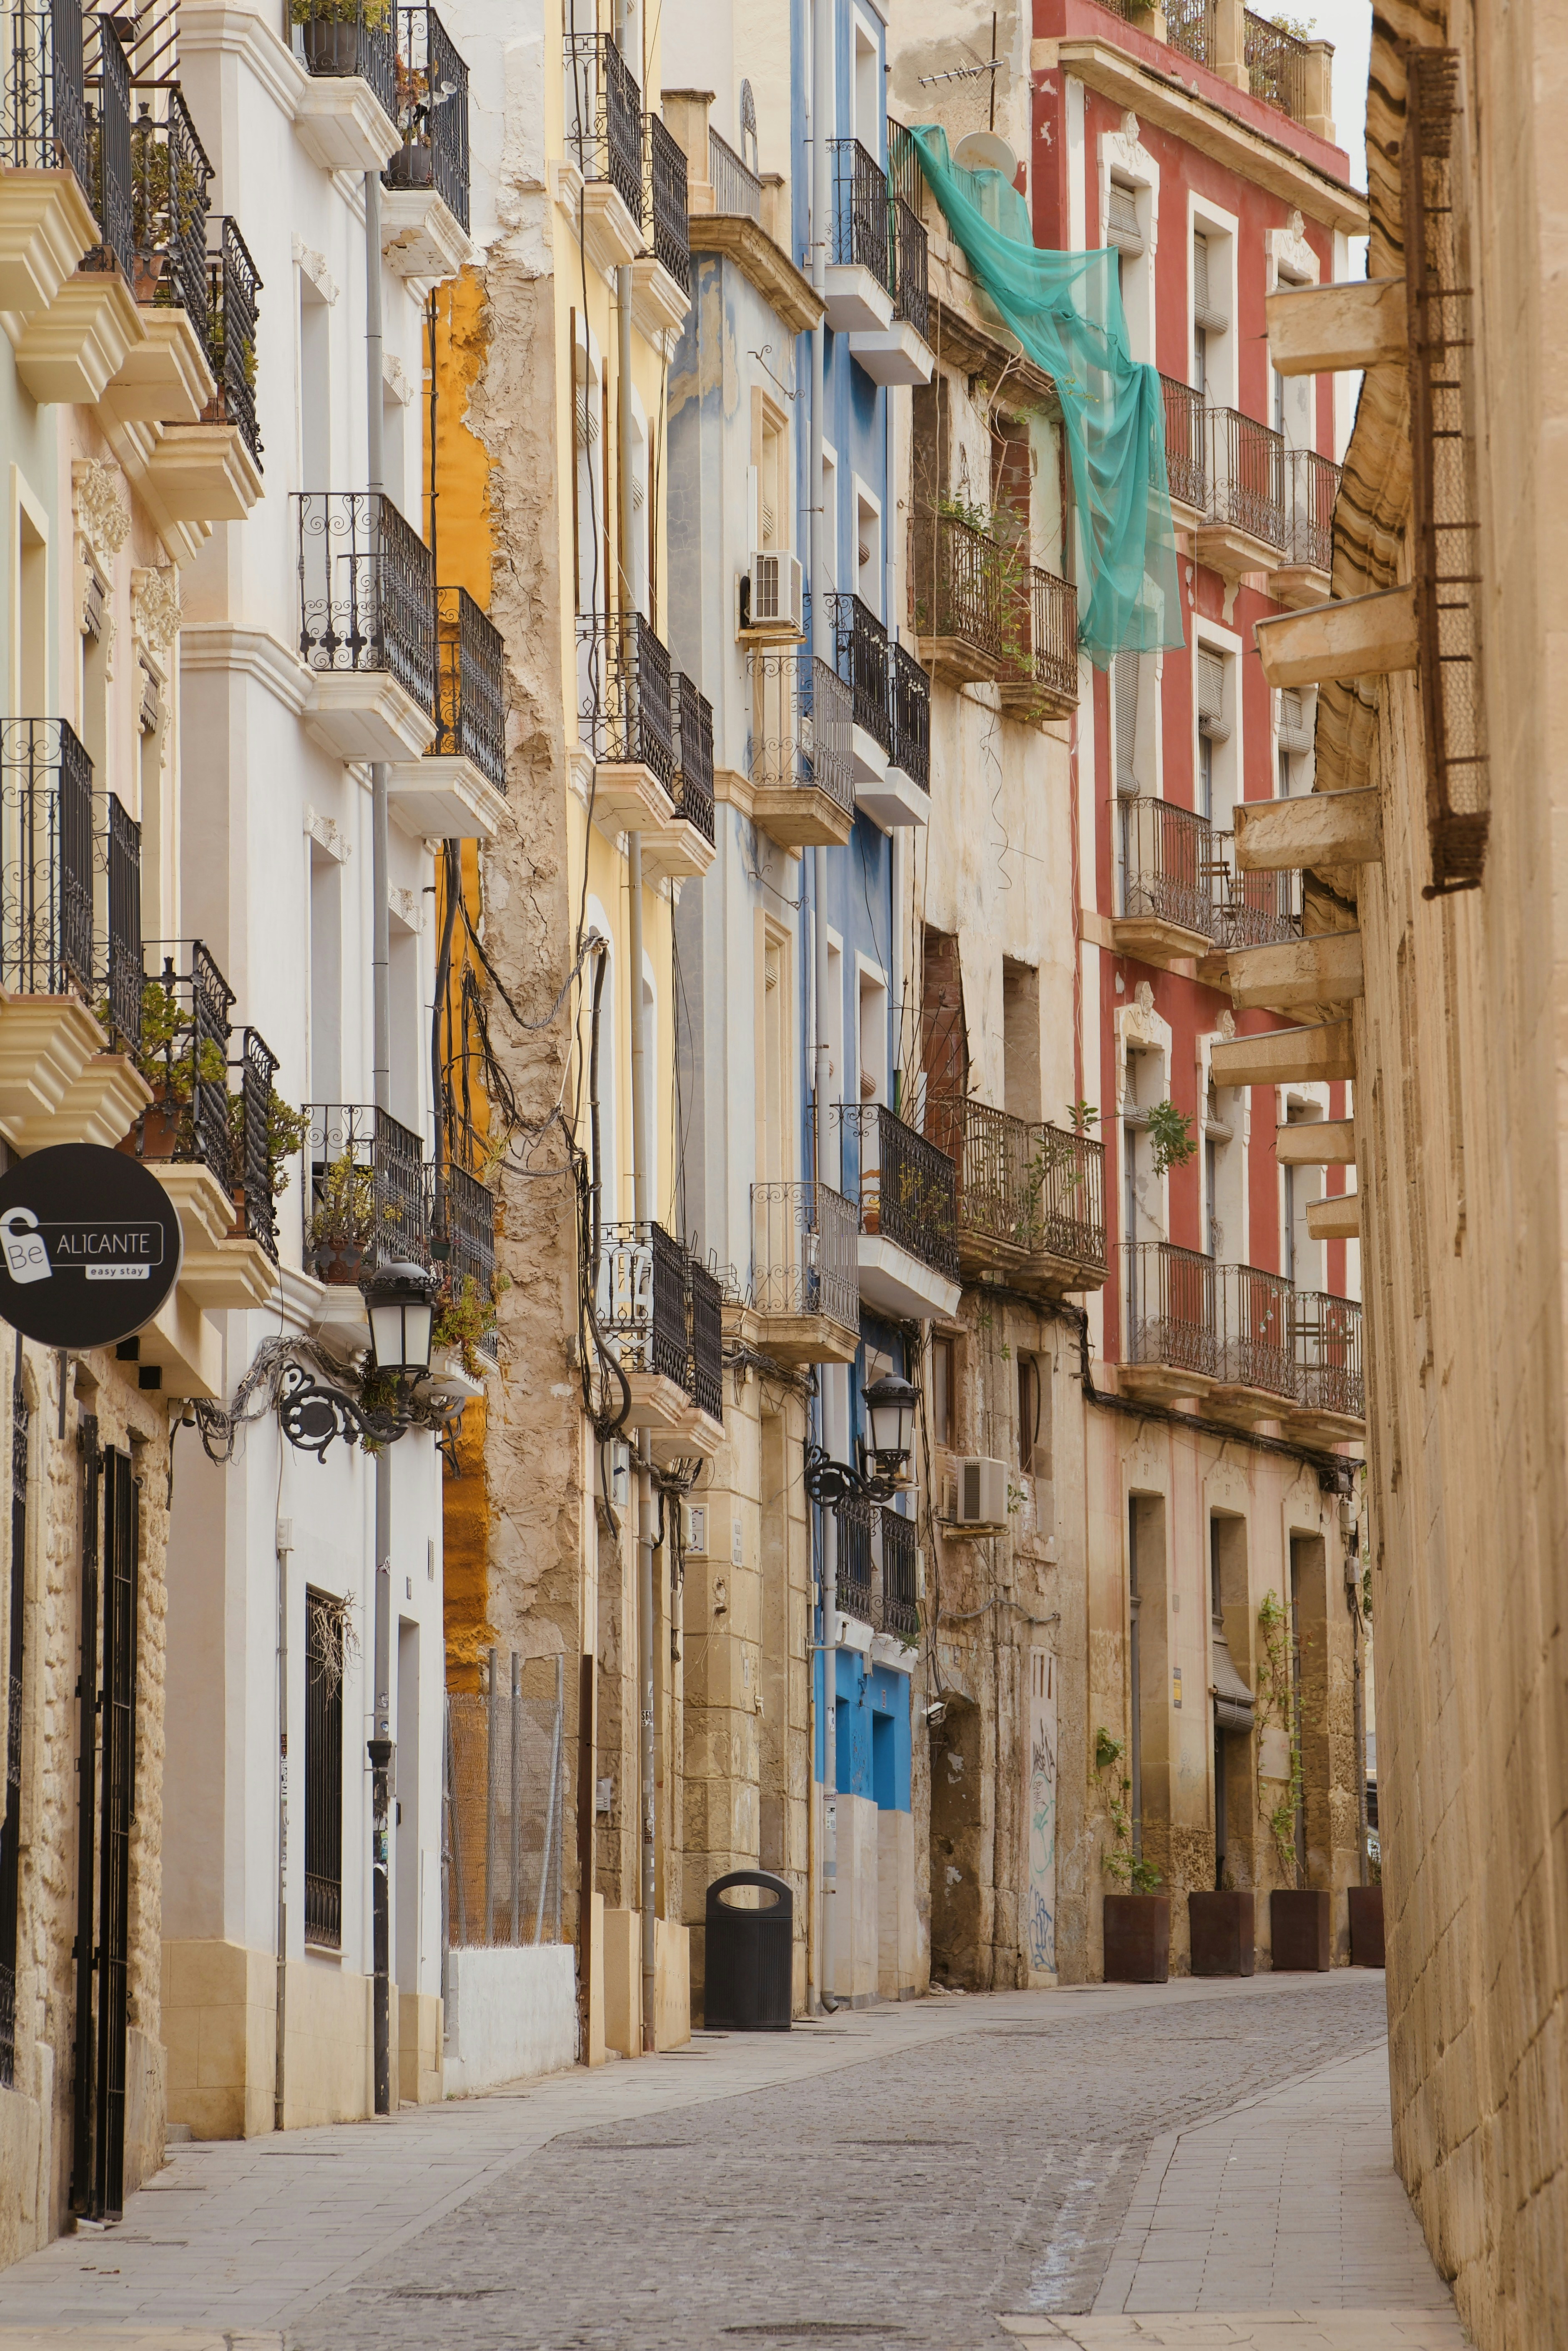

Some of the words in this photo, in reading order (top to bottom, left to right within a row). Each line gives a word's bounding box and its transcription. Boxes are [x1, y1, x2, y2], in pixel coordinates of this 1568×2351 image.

[8, 1245, 44, 1270] Be
[57, 1233, 150, 1254] ALICANTE
[90, 1268, 116, 1276] easy
[120, 1267, 144, 1276] stay
